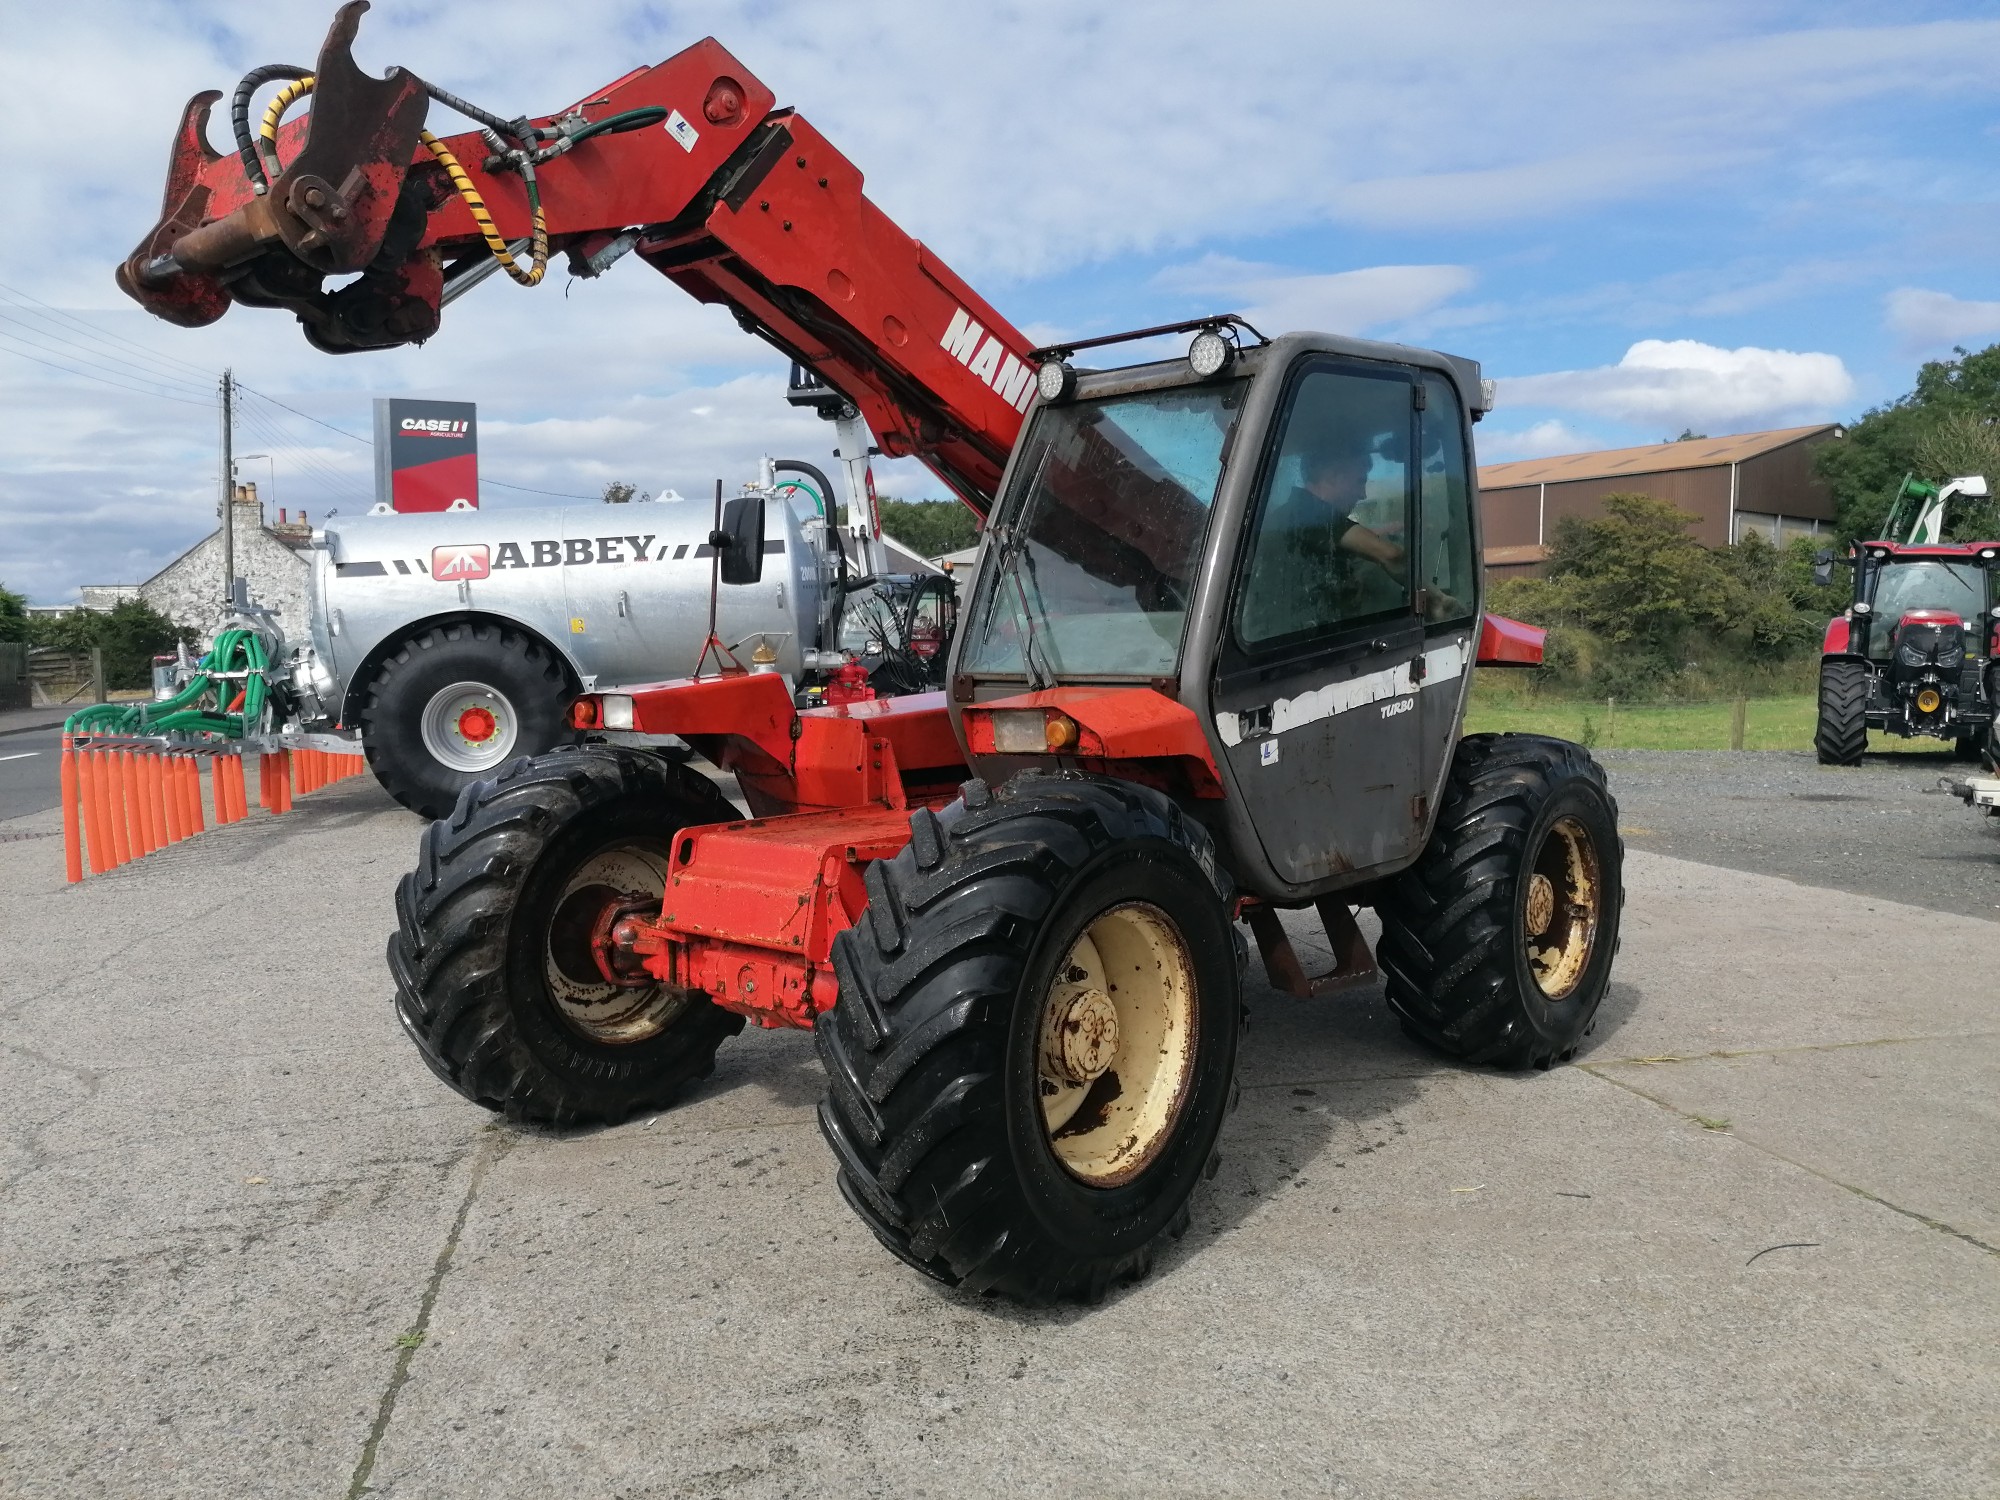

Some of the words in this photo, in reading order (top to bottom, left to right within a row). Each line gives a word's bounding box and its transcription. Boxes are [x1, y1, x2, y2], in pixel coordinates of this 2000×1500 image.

[940, 307, 1038, 415] MANI
[401, 418, 451, 432] CASE
[491, 534, 656, 569] ABBEY
[1380, 697, 1414, 720] TURBO
